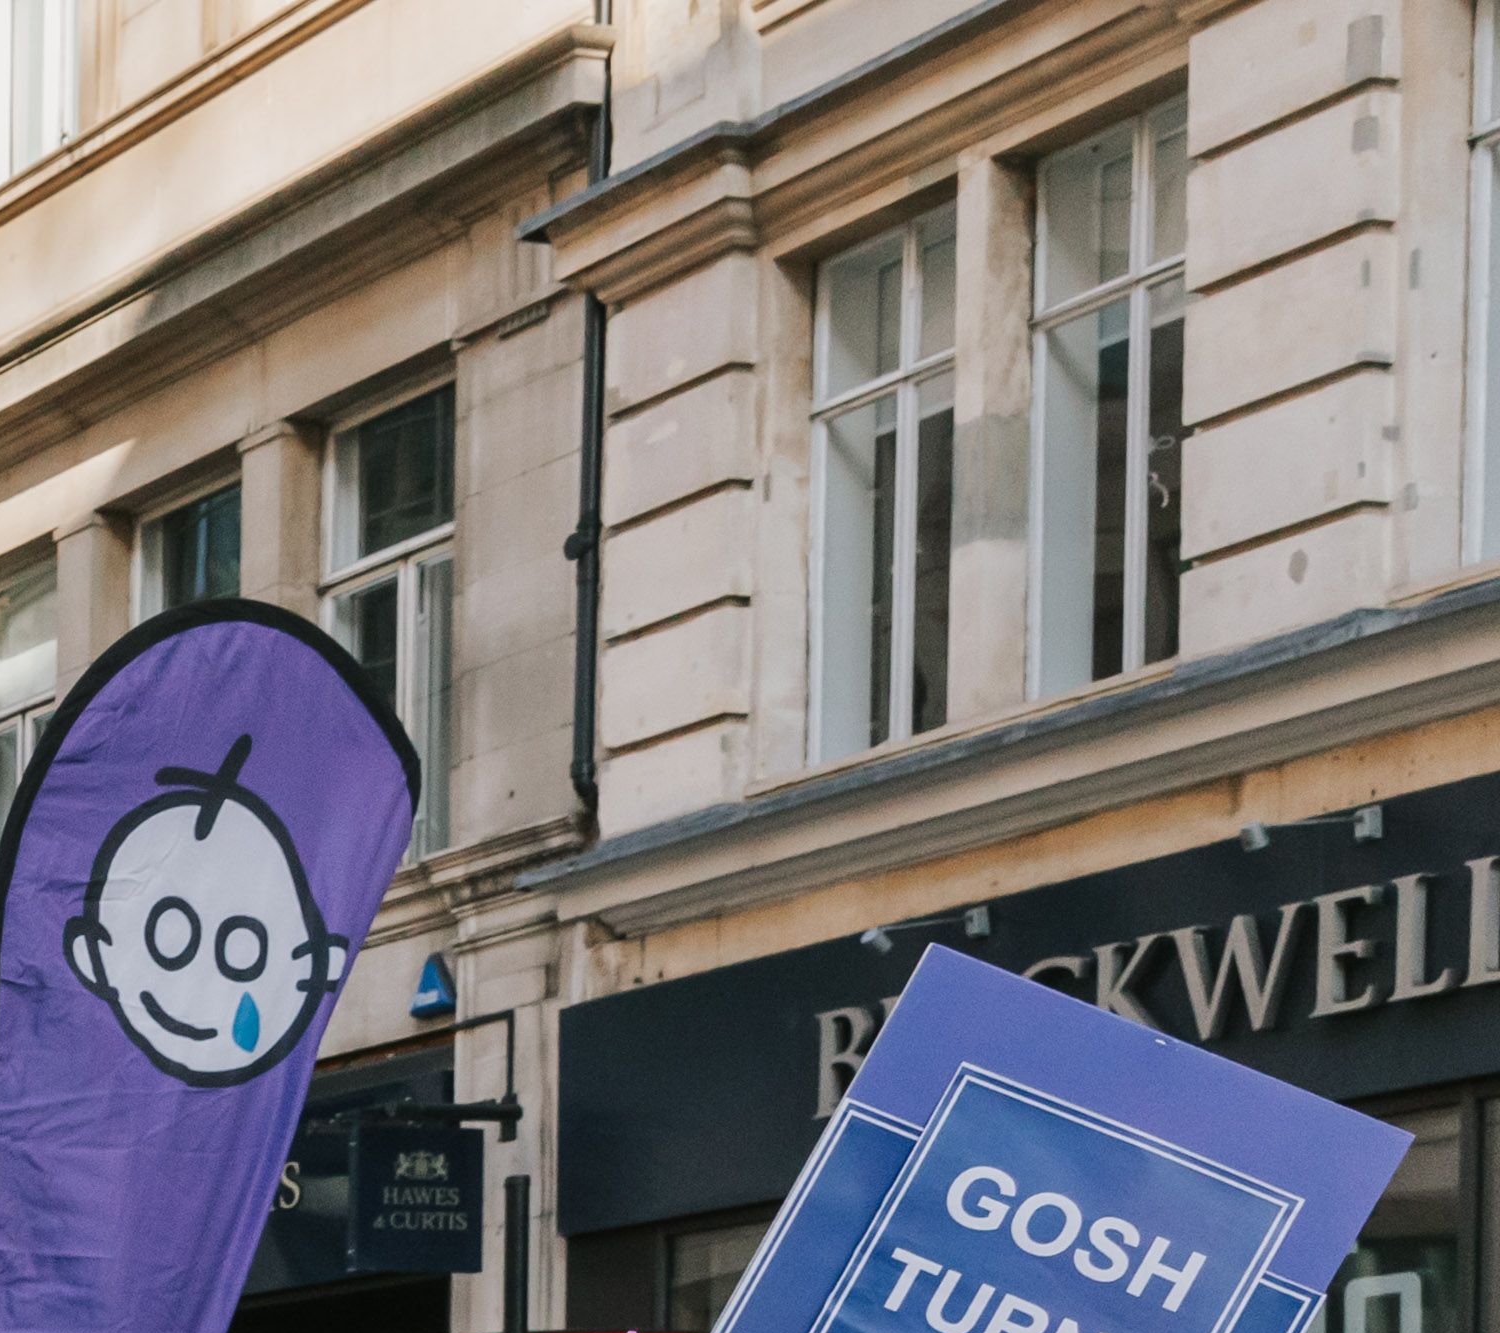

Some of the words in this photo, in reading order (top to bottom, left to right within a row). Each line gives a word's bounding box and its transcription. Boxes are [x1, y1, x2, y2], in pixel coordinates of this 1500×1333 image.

[383, 1187, 460, 1205] HAWES
[389, 1211, 468, 1230] CURTIS
[947, 1166, 1207, 1312] GOSH
